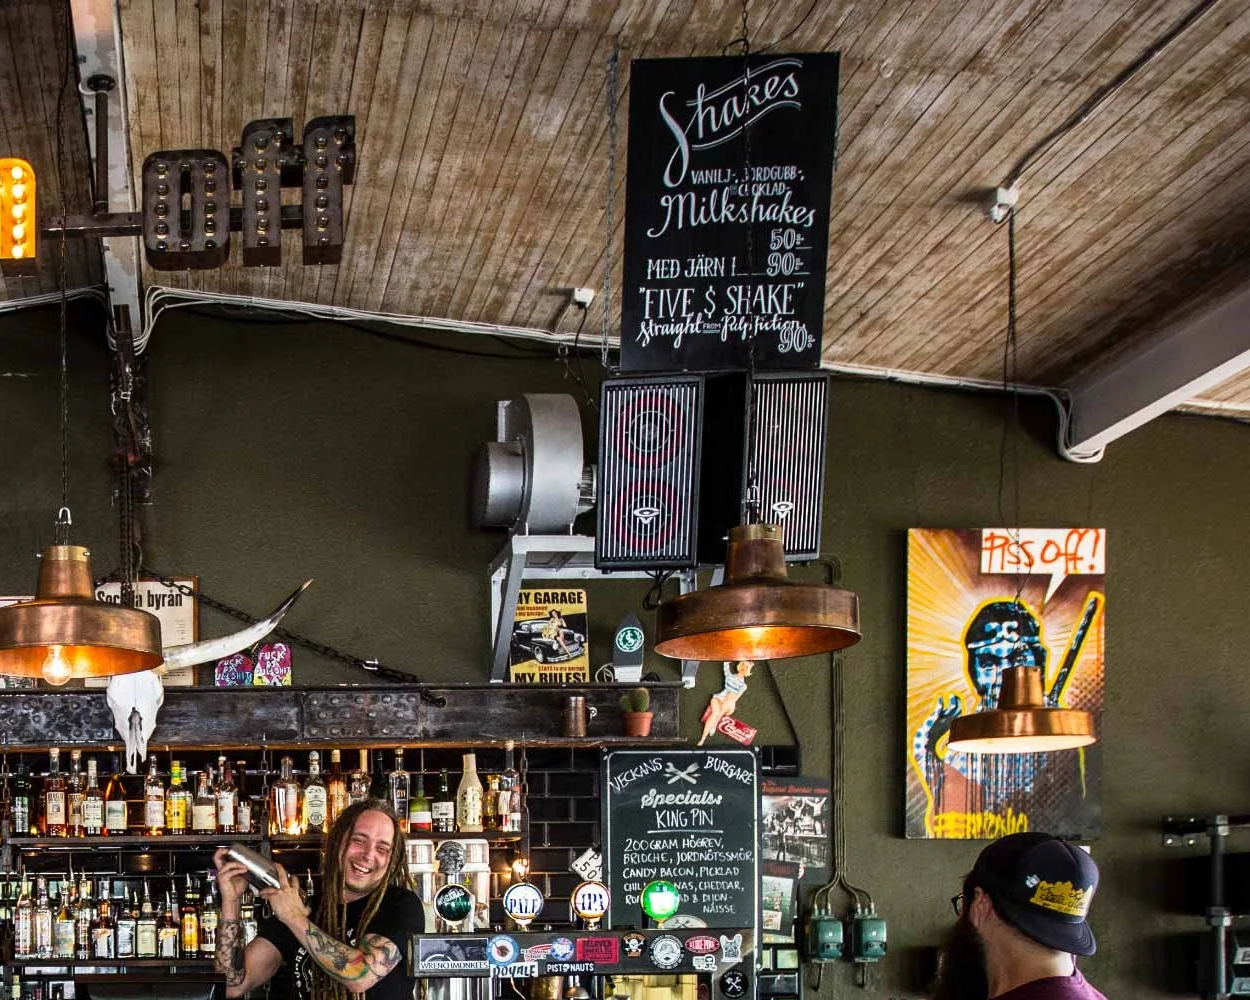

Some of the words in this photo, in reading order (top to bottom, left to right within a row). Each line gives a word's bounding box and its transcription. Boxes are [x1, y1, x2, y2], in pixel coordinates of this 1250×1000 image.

[659, 72, 799, 188] Shakes
[646, 185, 817, 238] Milkshakes
[647, 258, 680, 279] MED
[684, 254, 725, 277] JÄRN
[703, 285, 716, 319] $
[147, 588, 183, 610] byrån
[534, 592, 583, 604] GARAGE
[514, 673, 535, 683] MY
[610, 758, 662, 792] VECKANS
[704, 756, 755, 785] BURGARE
[641, 788, 723, 808] Specials:
[656, 809, 688, 829] KING
[690, 808, 714, 827] PIN
[624, 838, 648, 852] 200
[649, 839, 678, 850] GRAM
[623, 867, 656, 878] CANDY
[700, 866, 739, 877] PICKLAD
